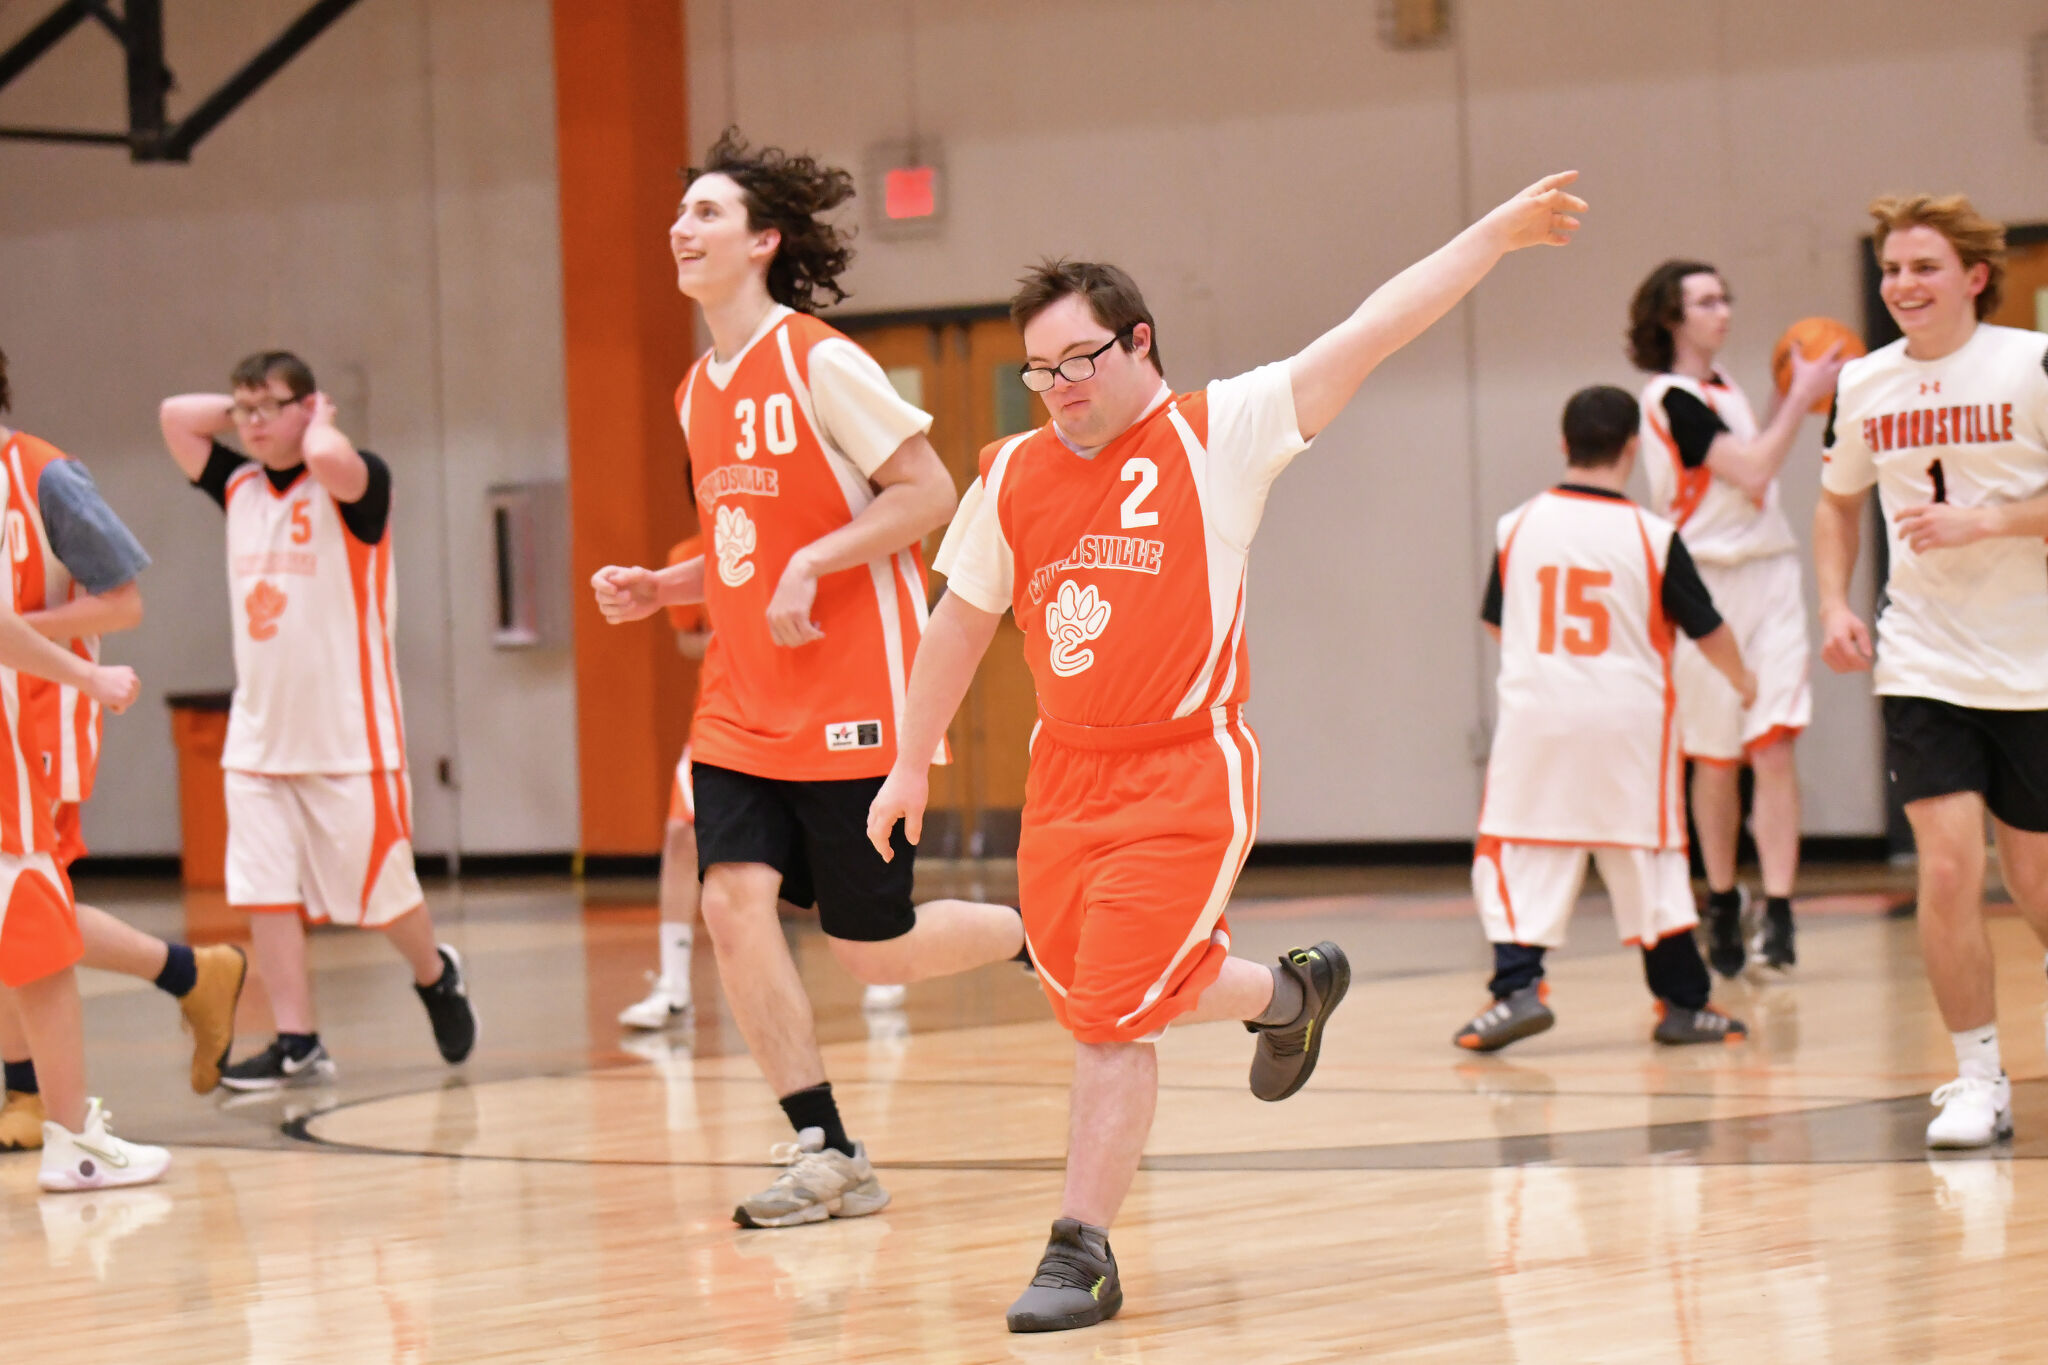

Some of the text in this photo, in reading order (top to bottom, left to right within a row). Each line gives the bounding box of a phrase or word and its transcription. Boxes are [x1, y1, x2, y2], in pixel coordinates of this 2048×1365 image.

[735, 393, 797, 460] 30
[1121, 457, 1158, 529] 2
[1926, 457, 1949, 504] 1
[291, 500, 312, 545] 5
[1537, 566, 1612, 657] 15
